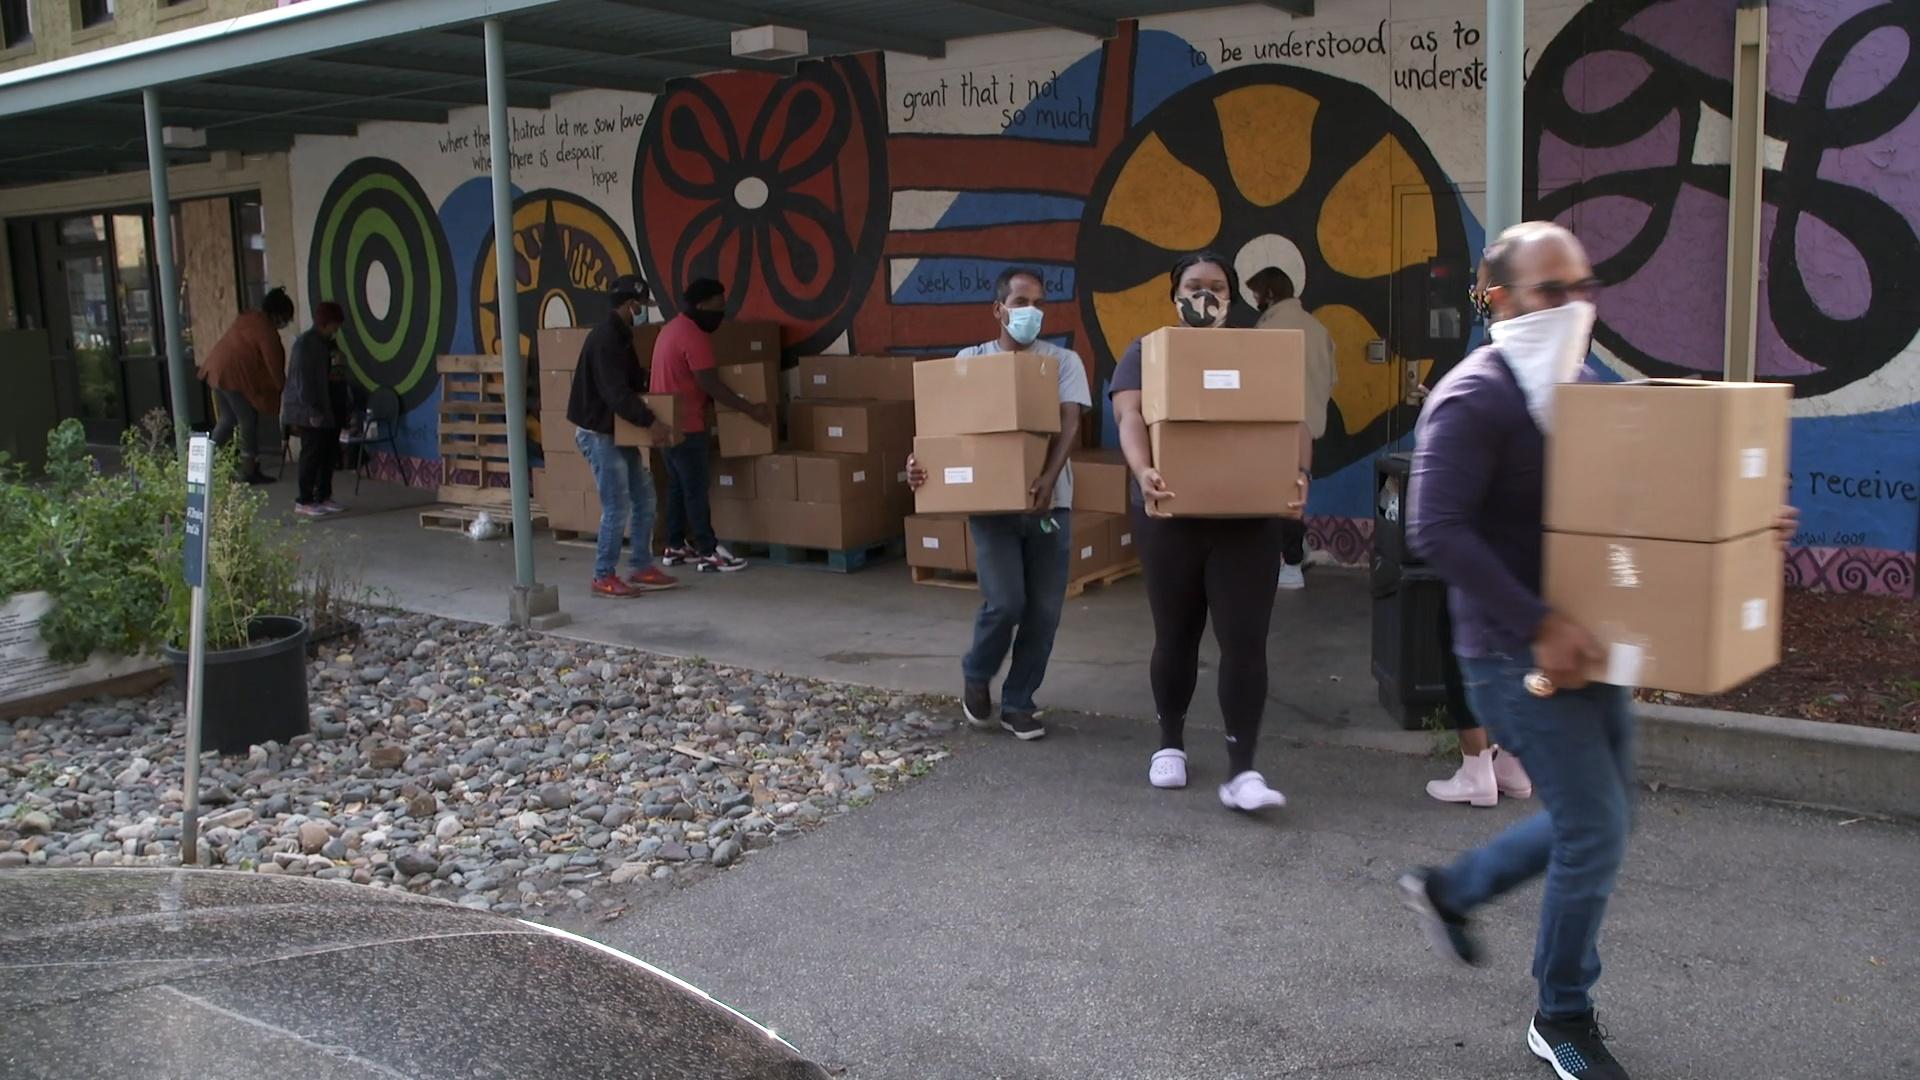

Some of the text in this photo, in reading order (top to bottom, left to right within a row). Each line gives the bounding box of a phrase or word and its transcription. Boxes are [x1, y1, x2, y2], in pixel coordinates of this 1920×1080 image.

[1190, 18, 1480, 67] to be understood as to
[903, 70, 1060, 122] grant that i not
[438, 131, 469, 153] where
[512, 115, 544, 142] hatred
[555, 114, 569, 136] let
[573, 122, 589, 136] me
[620, 104, 645, 132] love
[1000, 96, 1092, 131] so much
[539, 146, 549, 169] is
[591, 166, 618, 195] hope
[958, 269, 971, 292] to
[975, 266, 992, 290] be
[1809, 470, 1917, 501] receive
